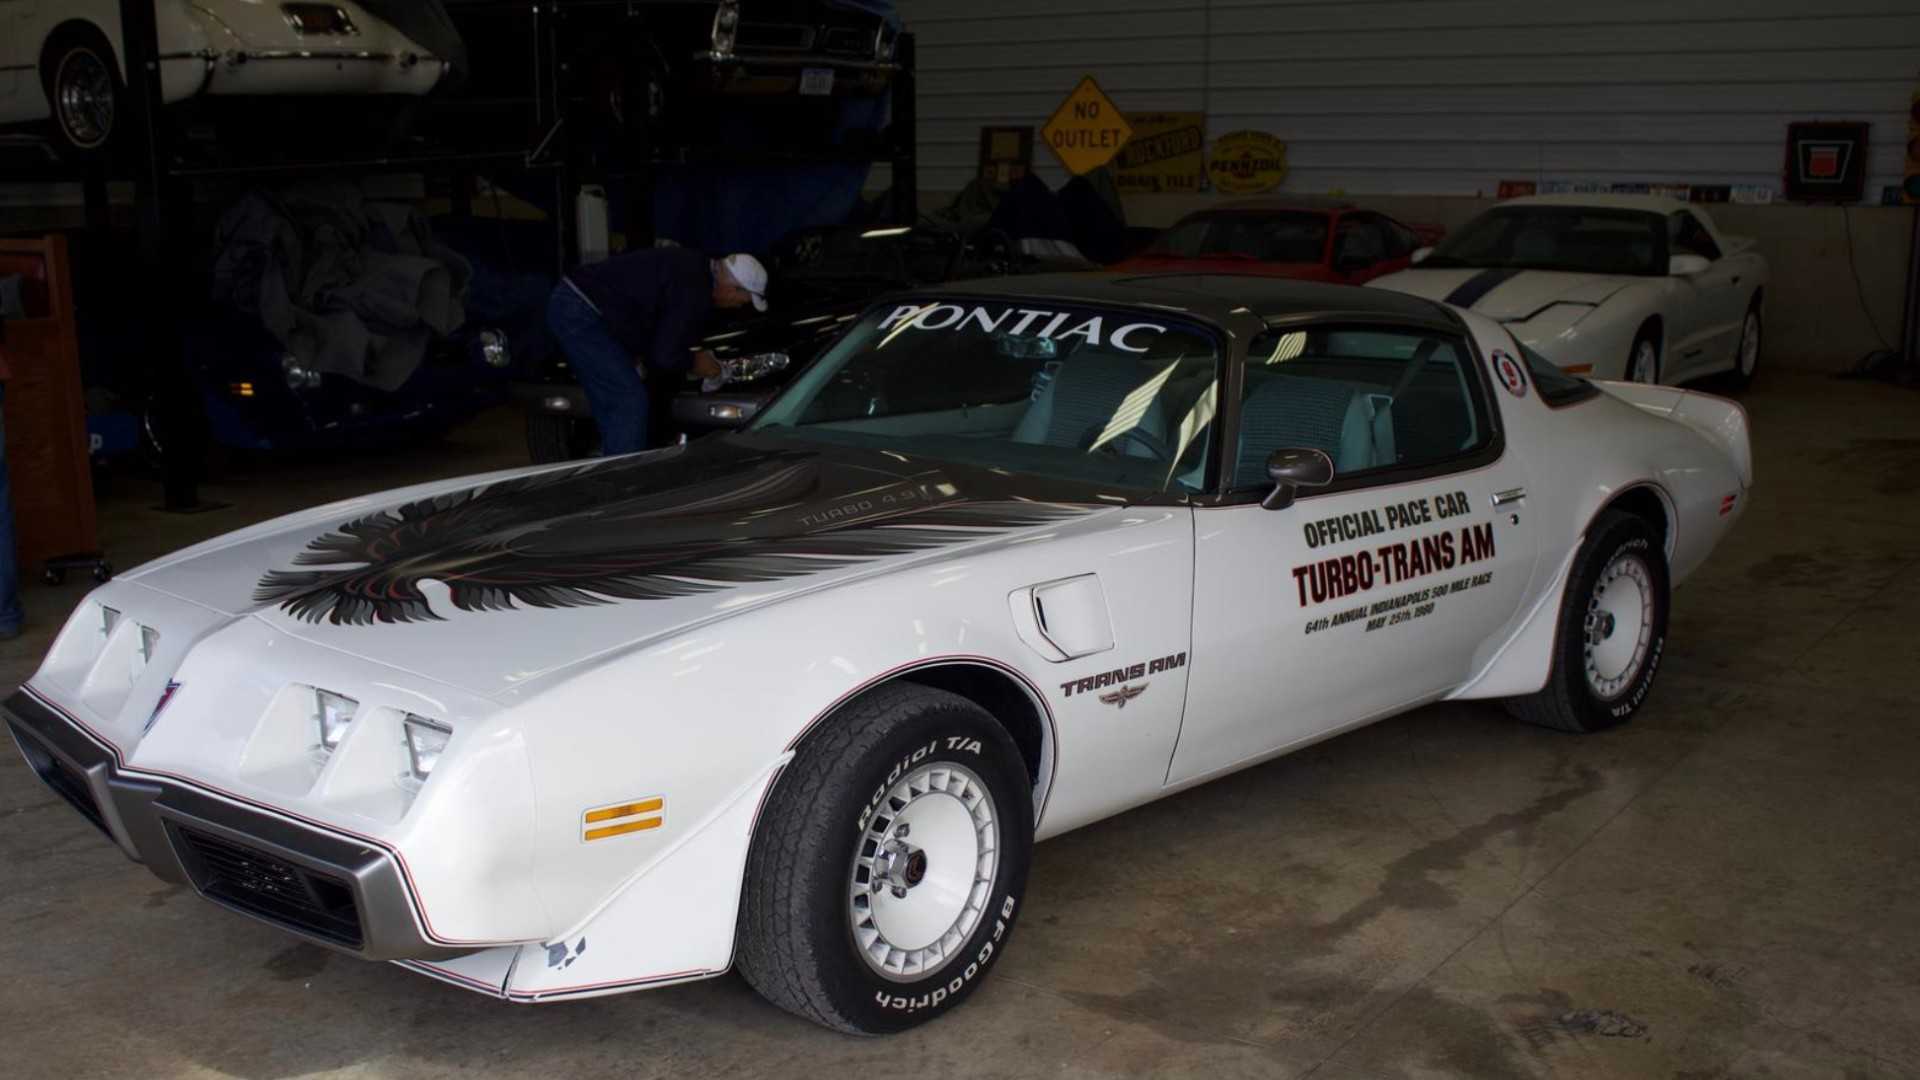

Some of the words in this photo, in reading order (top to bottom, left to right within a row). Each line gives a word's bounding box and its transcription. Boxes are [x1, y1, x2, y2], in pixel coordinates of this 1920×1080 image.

[1074, 101, 1100, 119] NO
[1052, 128, 1121, 148] OUTLET
[878, 304, 1167, 353] PONTIAC
[799, 499, 873, 527] TURBO
[1304, 510, 1385, 548] OFFICIAL
[1385, 498, 1432, 531] PACE
[1434, 491, 1471, 518] CAR
[1460, 522, 1496, 565] AM
[1305, 619, 1329, 634] 64th
[1331, 606, 1368, 628] ANNUAL
[1370, 588, 1430, 617] INDIANAPOLIS
[1431, 584, 1449, 599] 500
[1450, 576, 1473, 594] MILE
[1471, 571, 1493, 588] RACE
[1365, 618, 1387, 632] MAY
[1060, 662, 1146, 697] TRANS
[1148, 652, 1187, 675] AM
[857, 739, 938, 832] Radial
[945, 735, 983, 756] T/A
[874, 895, 1017, 1014] BFGoodrich
